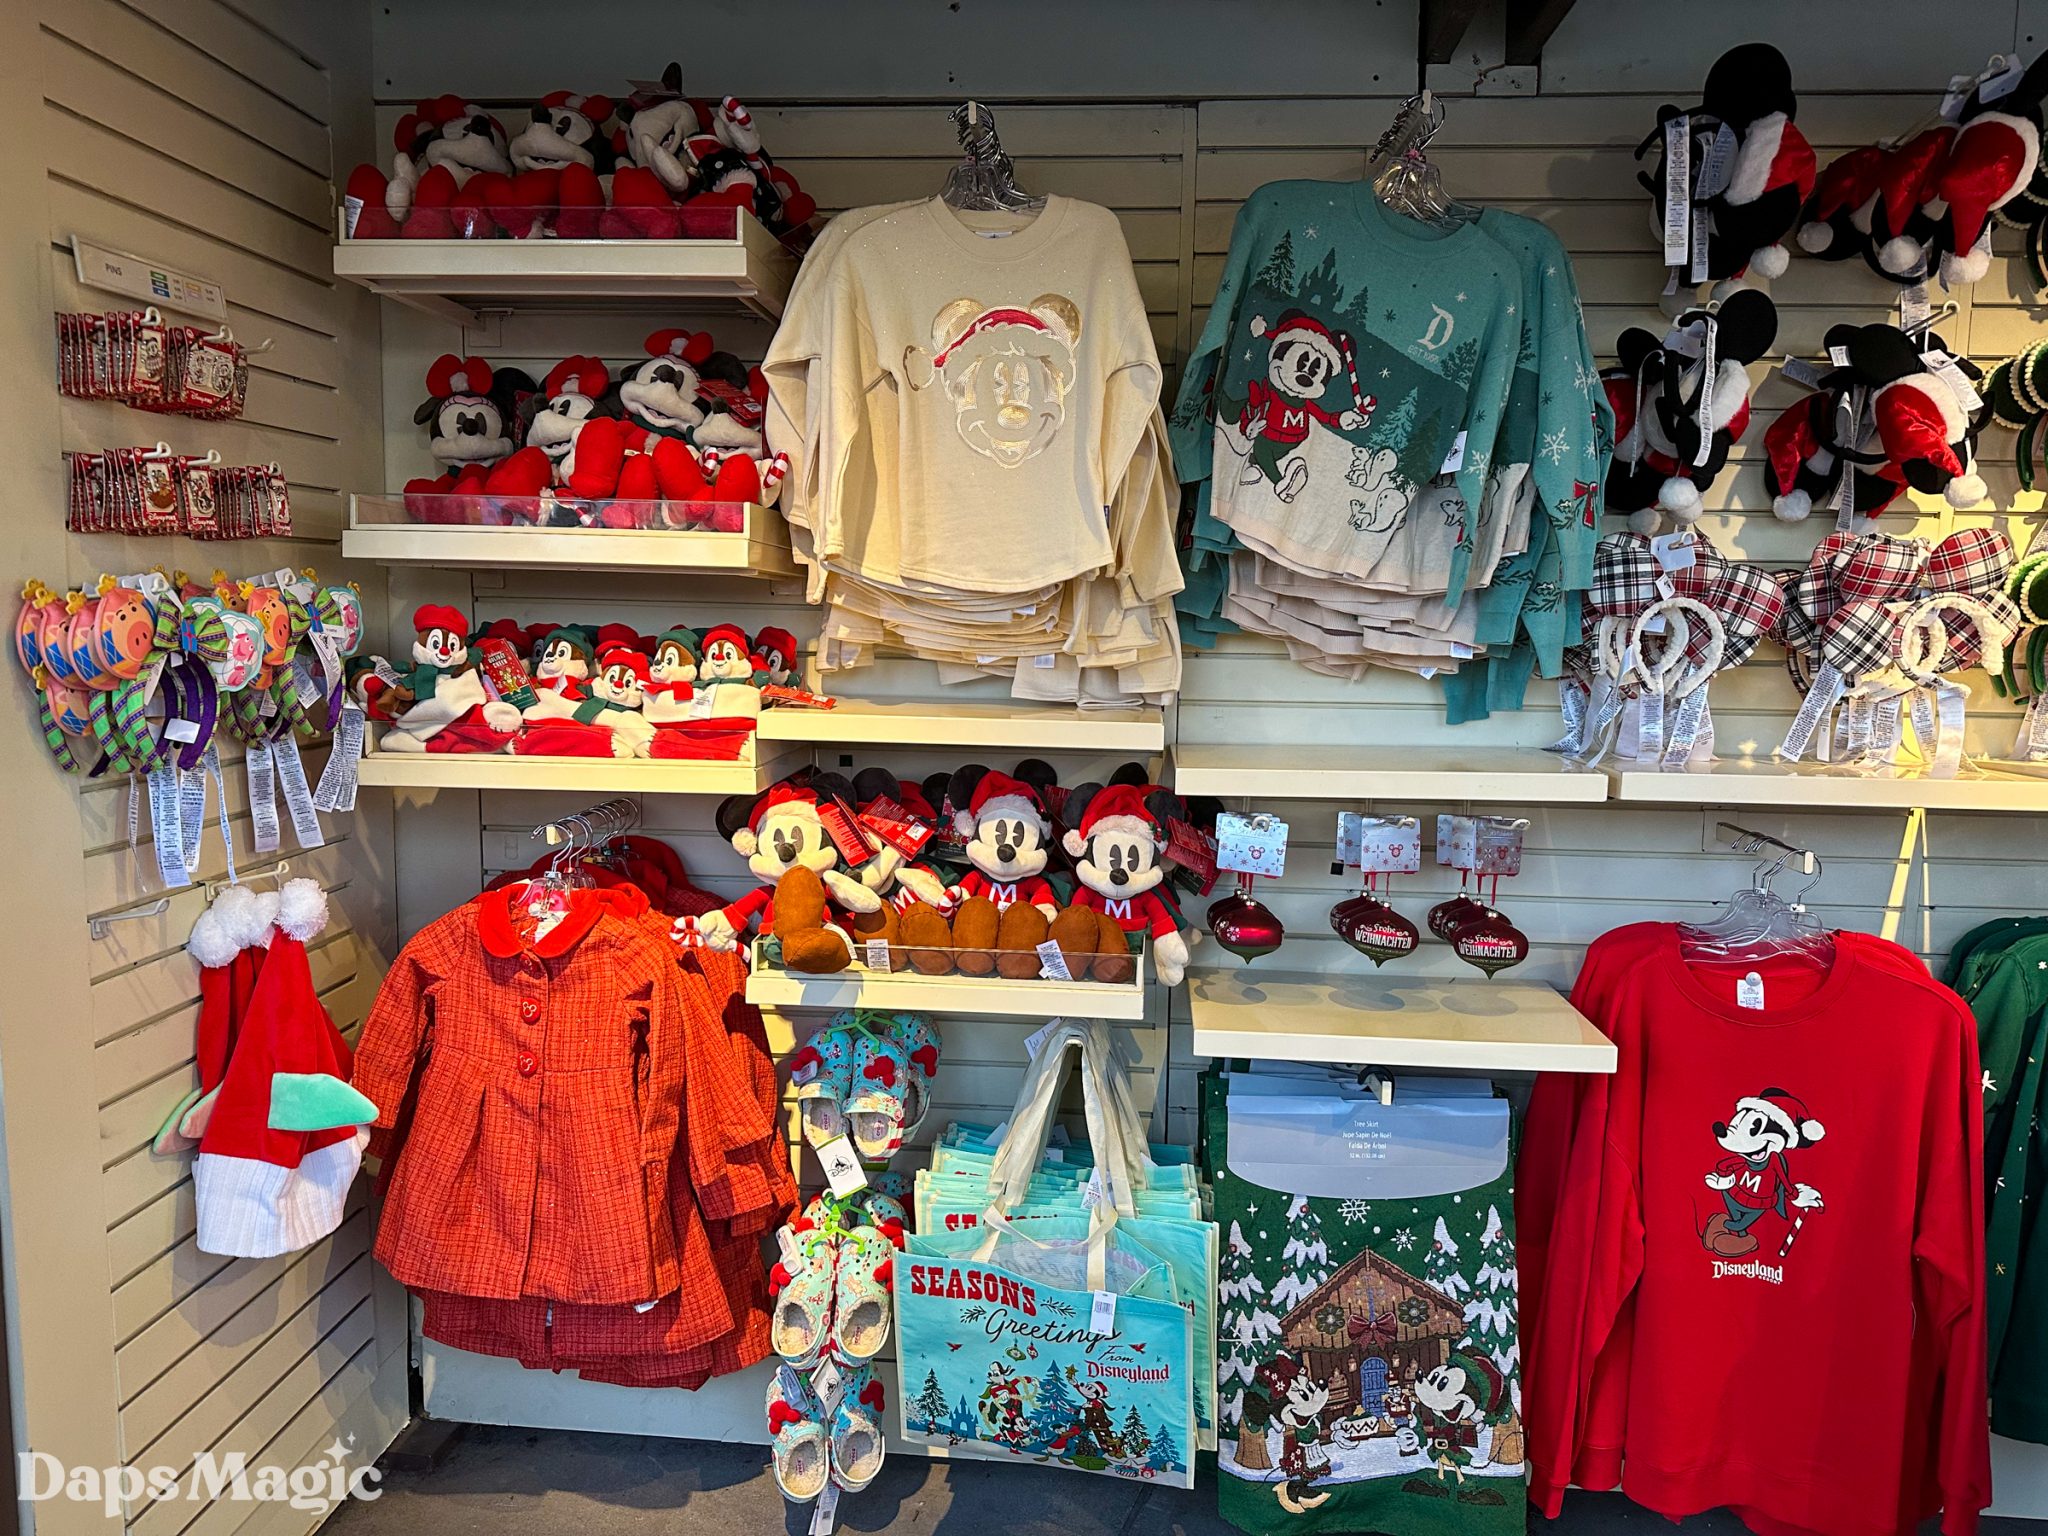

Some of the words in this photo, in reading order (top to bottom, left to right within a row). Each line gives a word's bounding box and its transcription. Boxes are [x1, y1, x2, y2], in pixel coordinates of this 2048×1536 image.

[105, 263, 122, 276] PINS
[1416, 303, 1454, 350] D
[1282, 409, 1304, 428] M
[988, 882, 1016, 903] M
[1105, 899, 1131, 919] M
[1355, 928, 1412, 949] WEIHNACHTEN
[1474, 934, 1499, 944] Frohe
[1458, 942, 1517, 959] WEIHNACHTEN
[1366, 1120, 1379, 1128] Skirt
[1371, 1131, 1378, 1139] De
[1739, 1170, 1762, 1193] M
[1711, 1259, 1783, 1282] Disneyland
[910, 1264, 1038, 1317] SEASON'S
[1097, 1345, 1135, 1363] From
[1084, 1359, 1170, 1383] Disneyland
